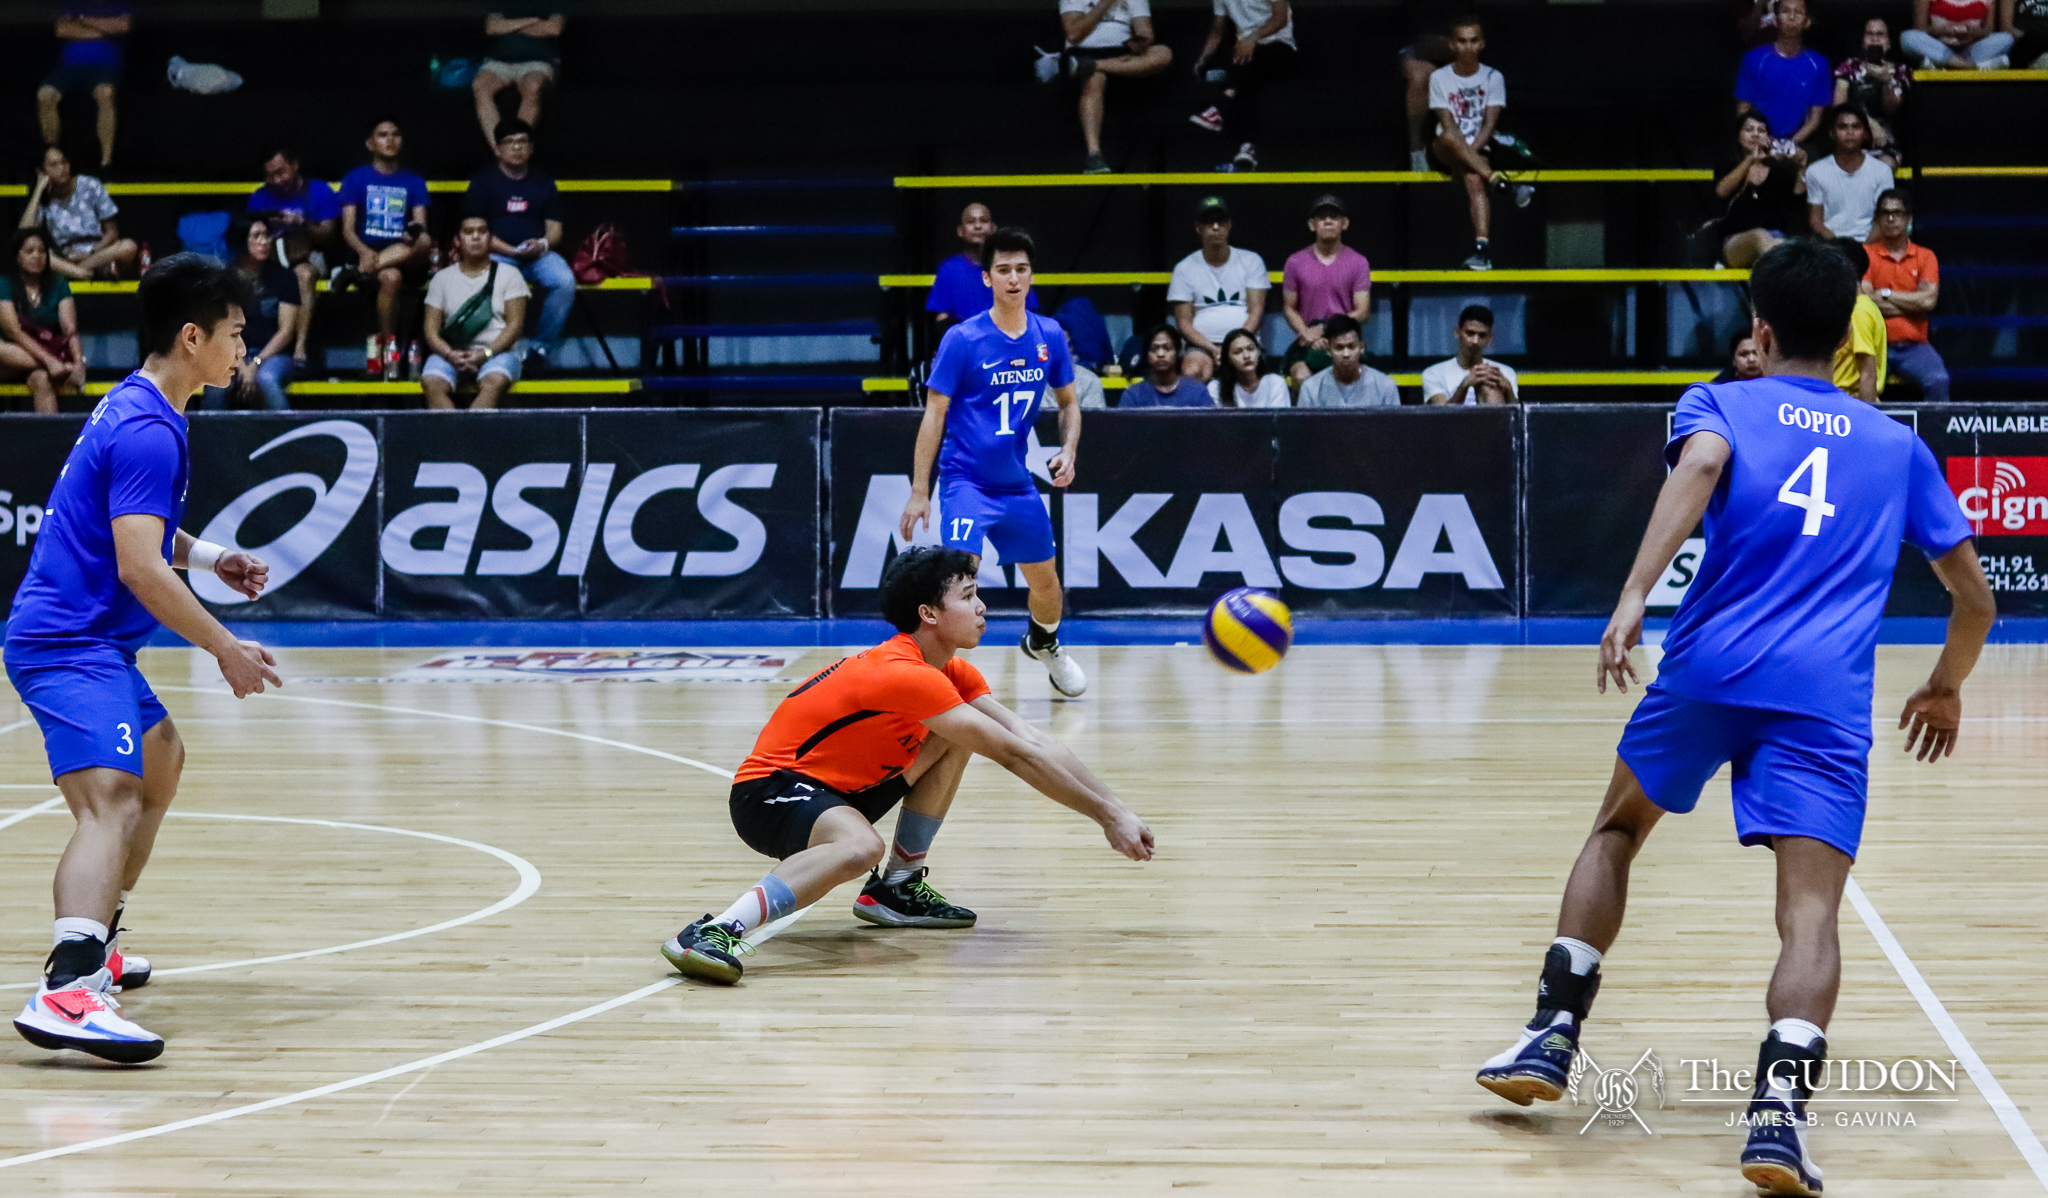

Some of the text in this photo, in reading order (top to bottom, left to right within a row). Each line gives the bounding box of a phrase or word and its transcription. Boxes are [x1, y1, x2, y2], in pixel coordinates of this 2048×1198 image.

[990, 368, 1043, 385] ATENEO
[993, 390, 1035, 435] 17
[1778, 403, 1851, 437] GOPIO
[1946, 416, 2048, 433] AVAILABLE
[1778, 447, 1835, 536] 4
[380, 462, 778, 576] asics
[840, 474, 1504, 590] MKASA
[950, 517, 974, 541] 17
[1987, 574, 2048, 591] H.261
[116, 723, 134, 755] 3
